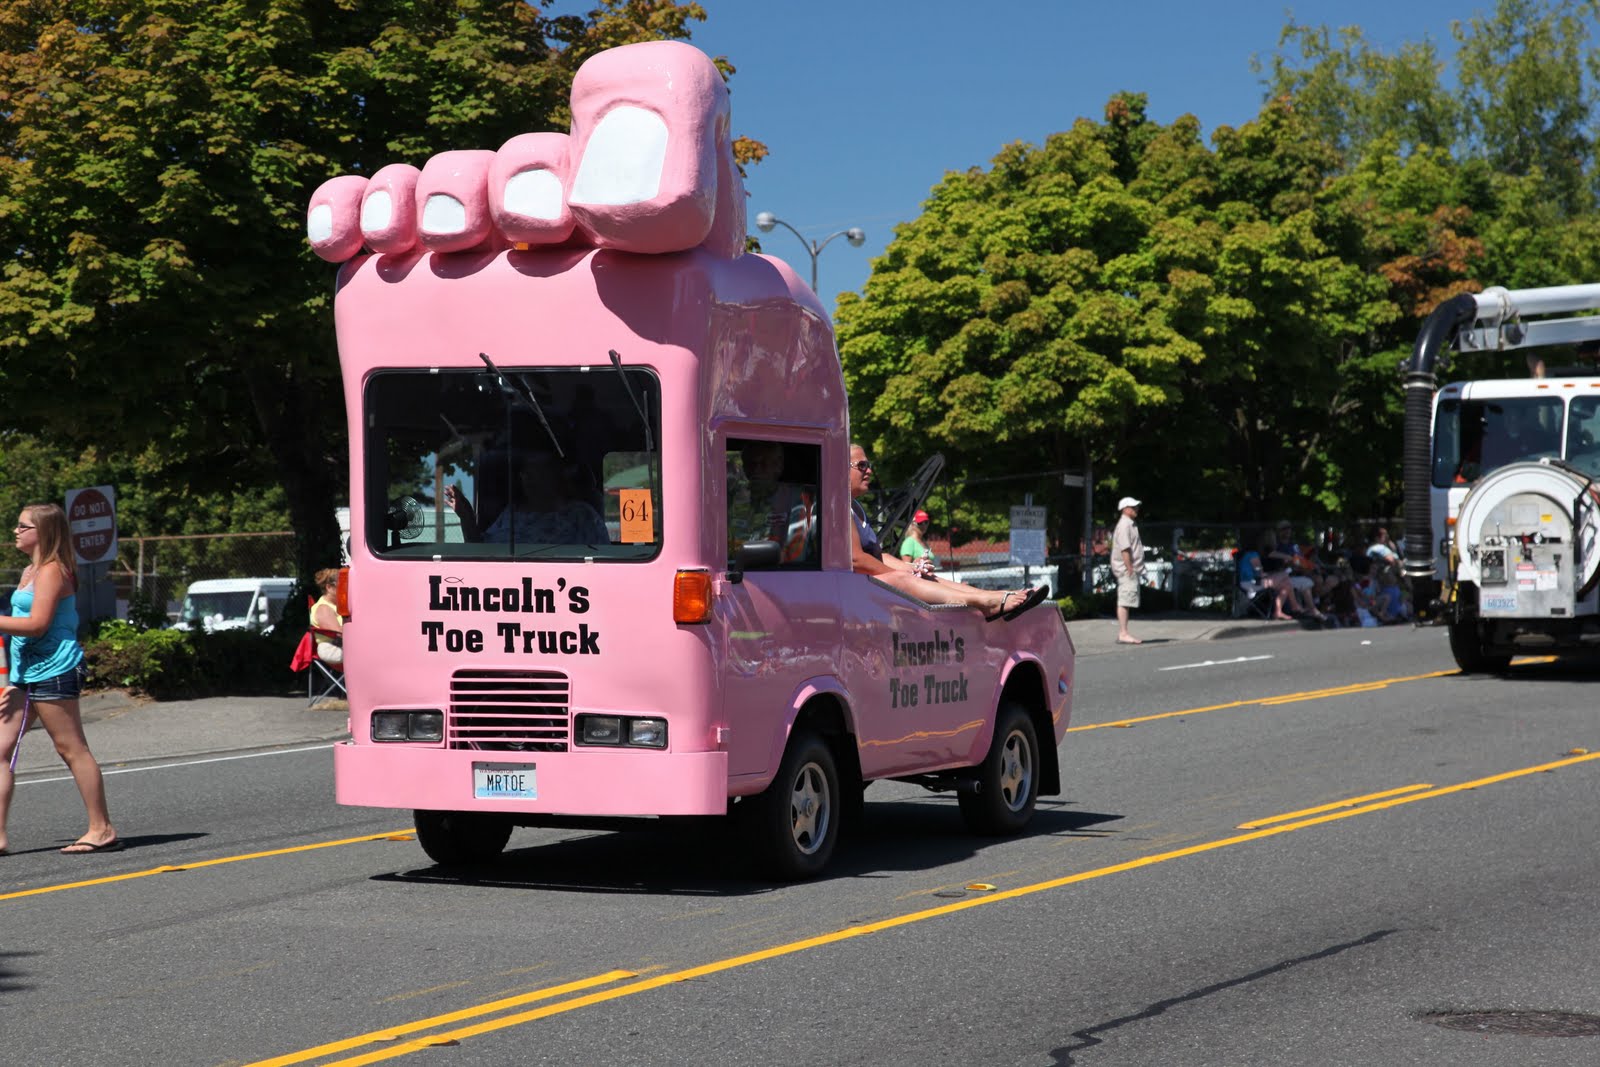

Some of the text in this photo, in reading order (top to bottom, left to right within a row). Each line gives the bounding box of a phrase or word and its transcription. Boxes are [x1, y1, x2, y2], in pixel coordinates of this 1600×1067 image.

[75, 503, 106, 516] DO NOT
[622, 499, 649, 522] 64
[80, 535, 106, 548] ENTER
[428, 575, 590, 614] Lincoln's
[421, 621, 600, 655] Toe Truck
[893, 629, 965, 667] Lincoln's
[889, 672, 969, 709] Toe Truck
[486, 774, 526, 792] MRTOE
